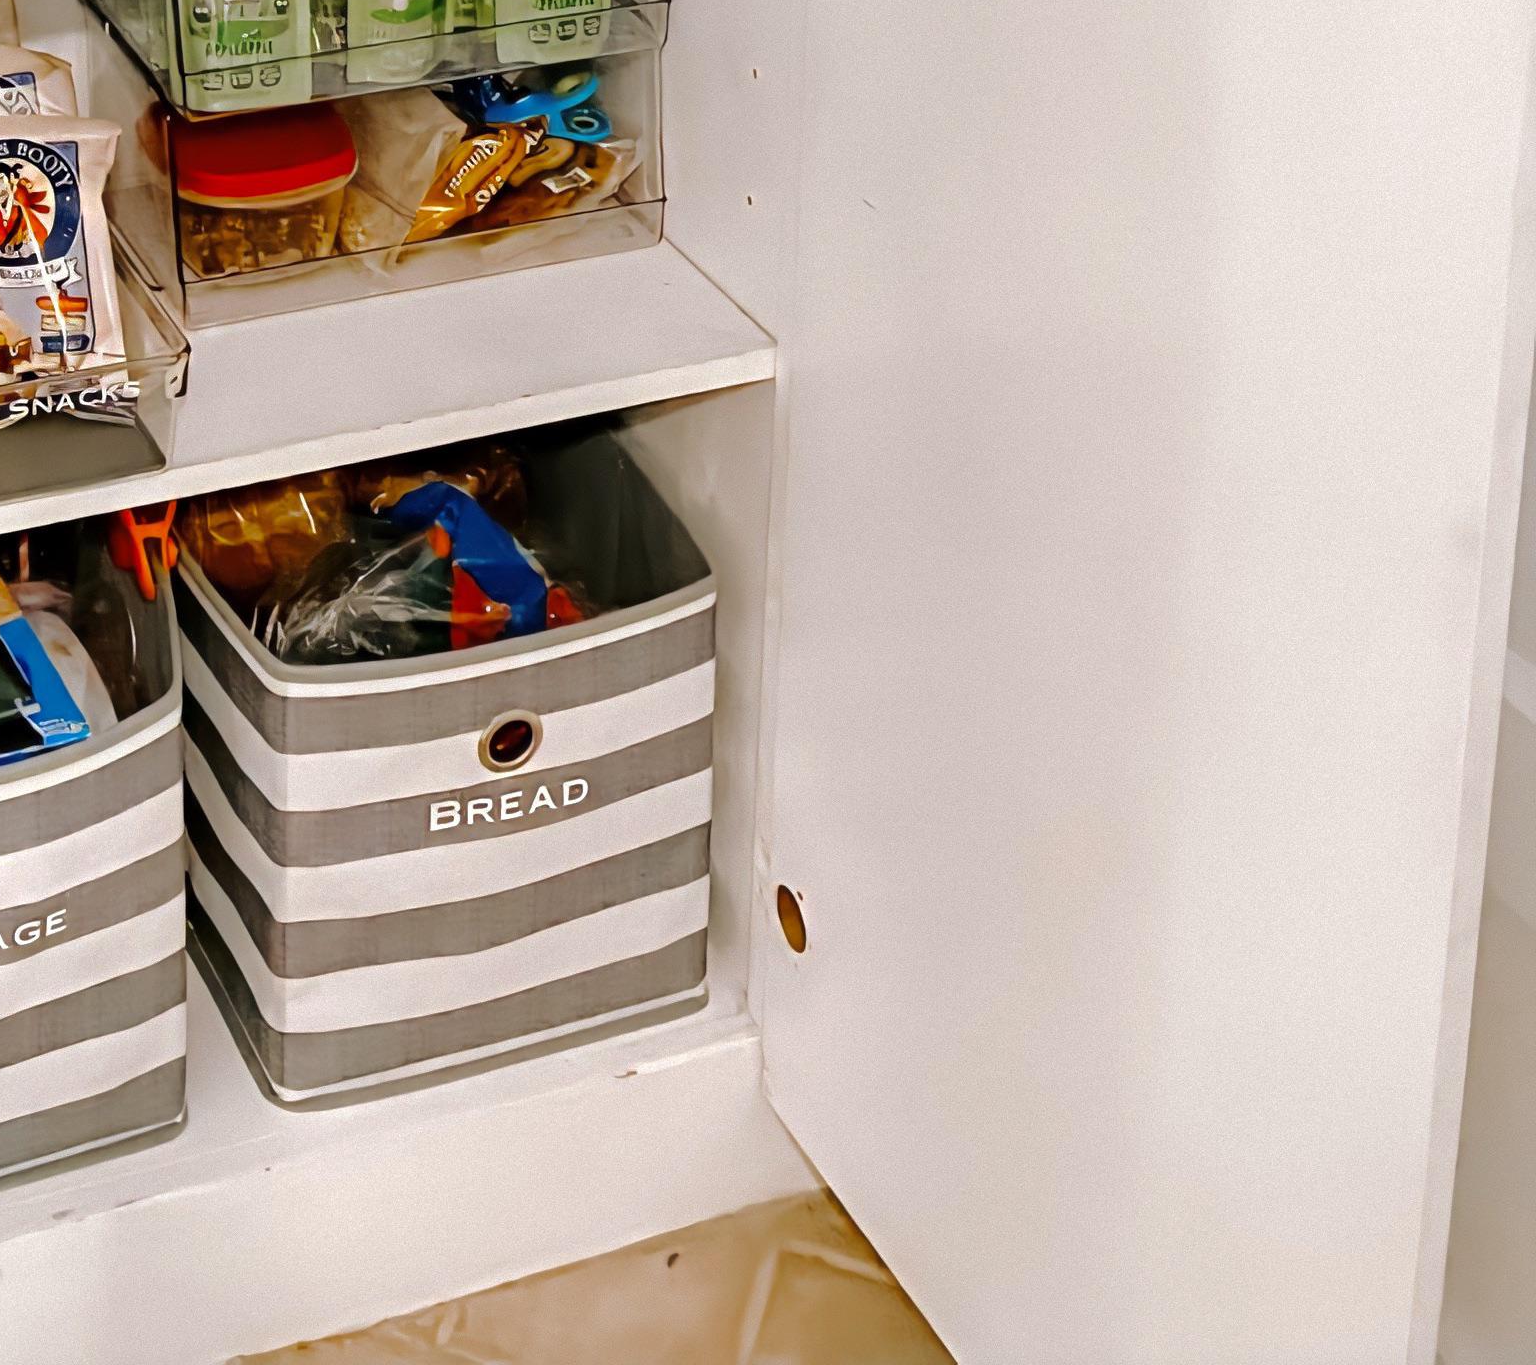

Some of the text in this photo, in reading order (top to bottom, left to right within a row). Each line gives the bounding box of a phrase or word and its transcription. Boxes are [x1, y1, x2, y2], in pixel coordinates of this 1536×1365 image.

[16, 140, 74, 188] BOOTY
[7, 380, 142, 420] SNACKS
[428, 778, 589, 833] BREAD
